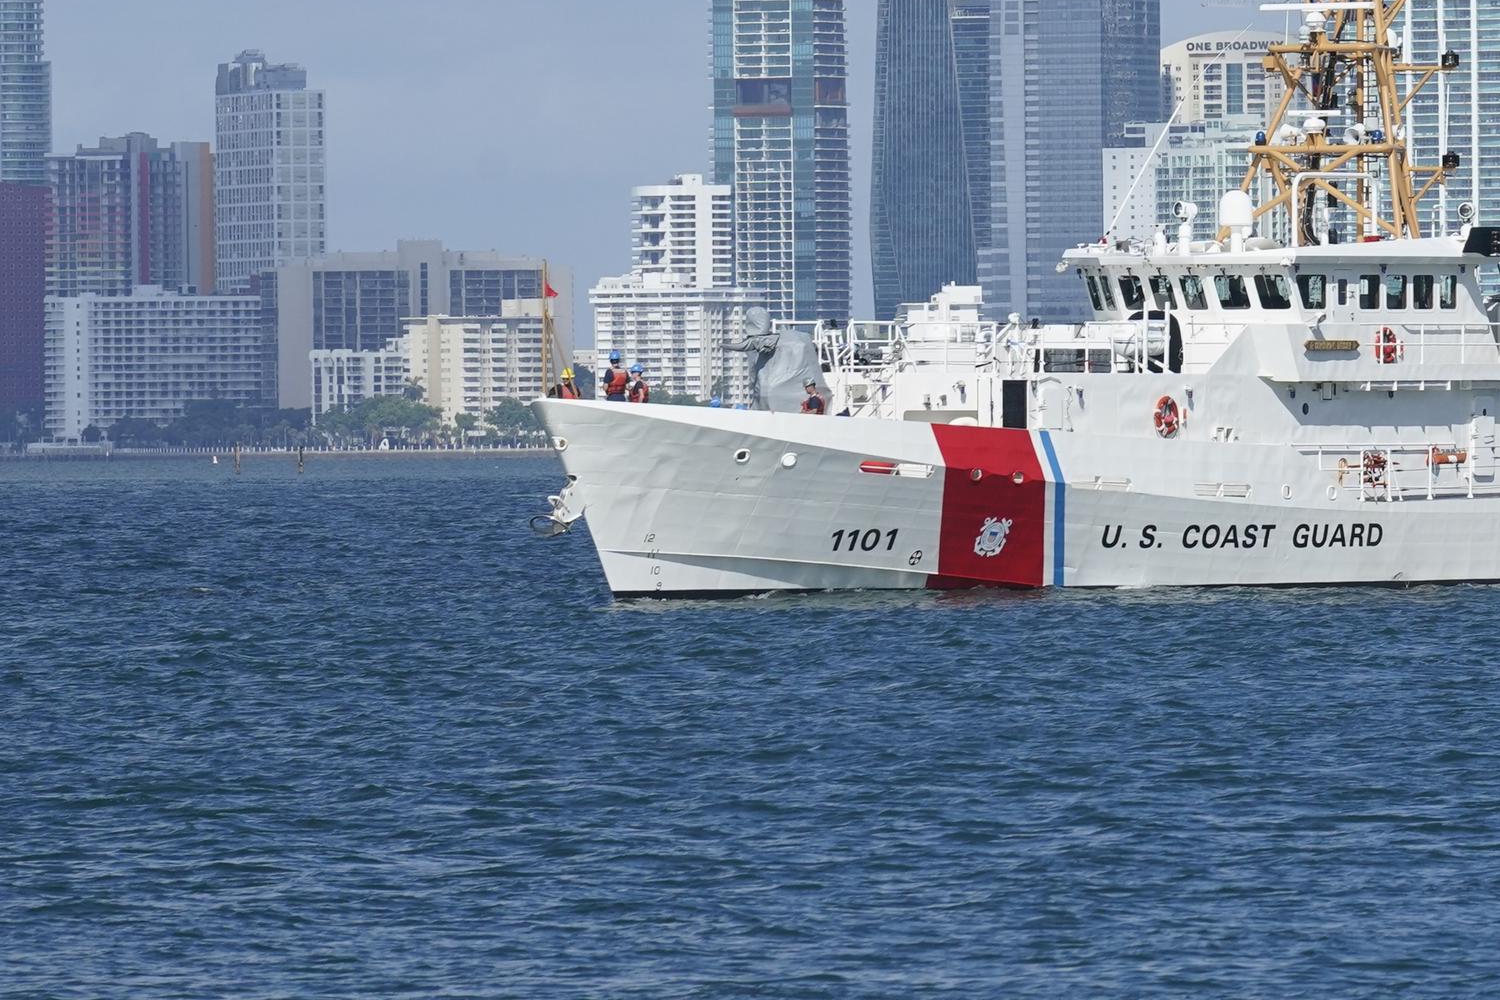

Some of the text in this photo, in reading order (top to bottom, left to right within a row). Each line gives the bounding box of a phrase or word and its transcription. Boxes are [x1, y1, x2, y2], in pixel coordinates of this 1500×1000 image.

[1186, 42, 1211, 51] ONE
[643, 533, 655, 542] 12
[831, 528, 899, 551] 1101
[1101, 523, 1383, 548] U. S. COAST GUARD
[650, 566, 660, 575] 10
